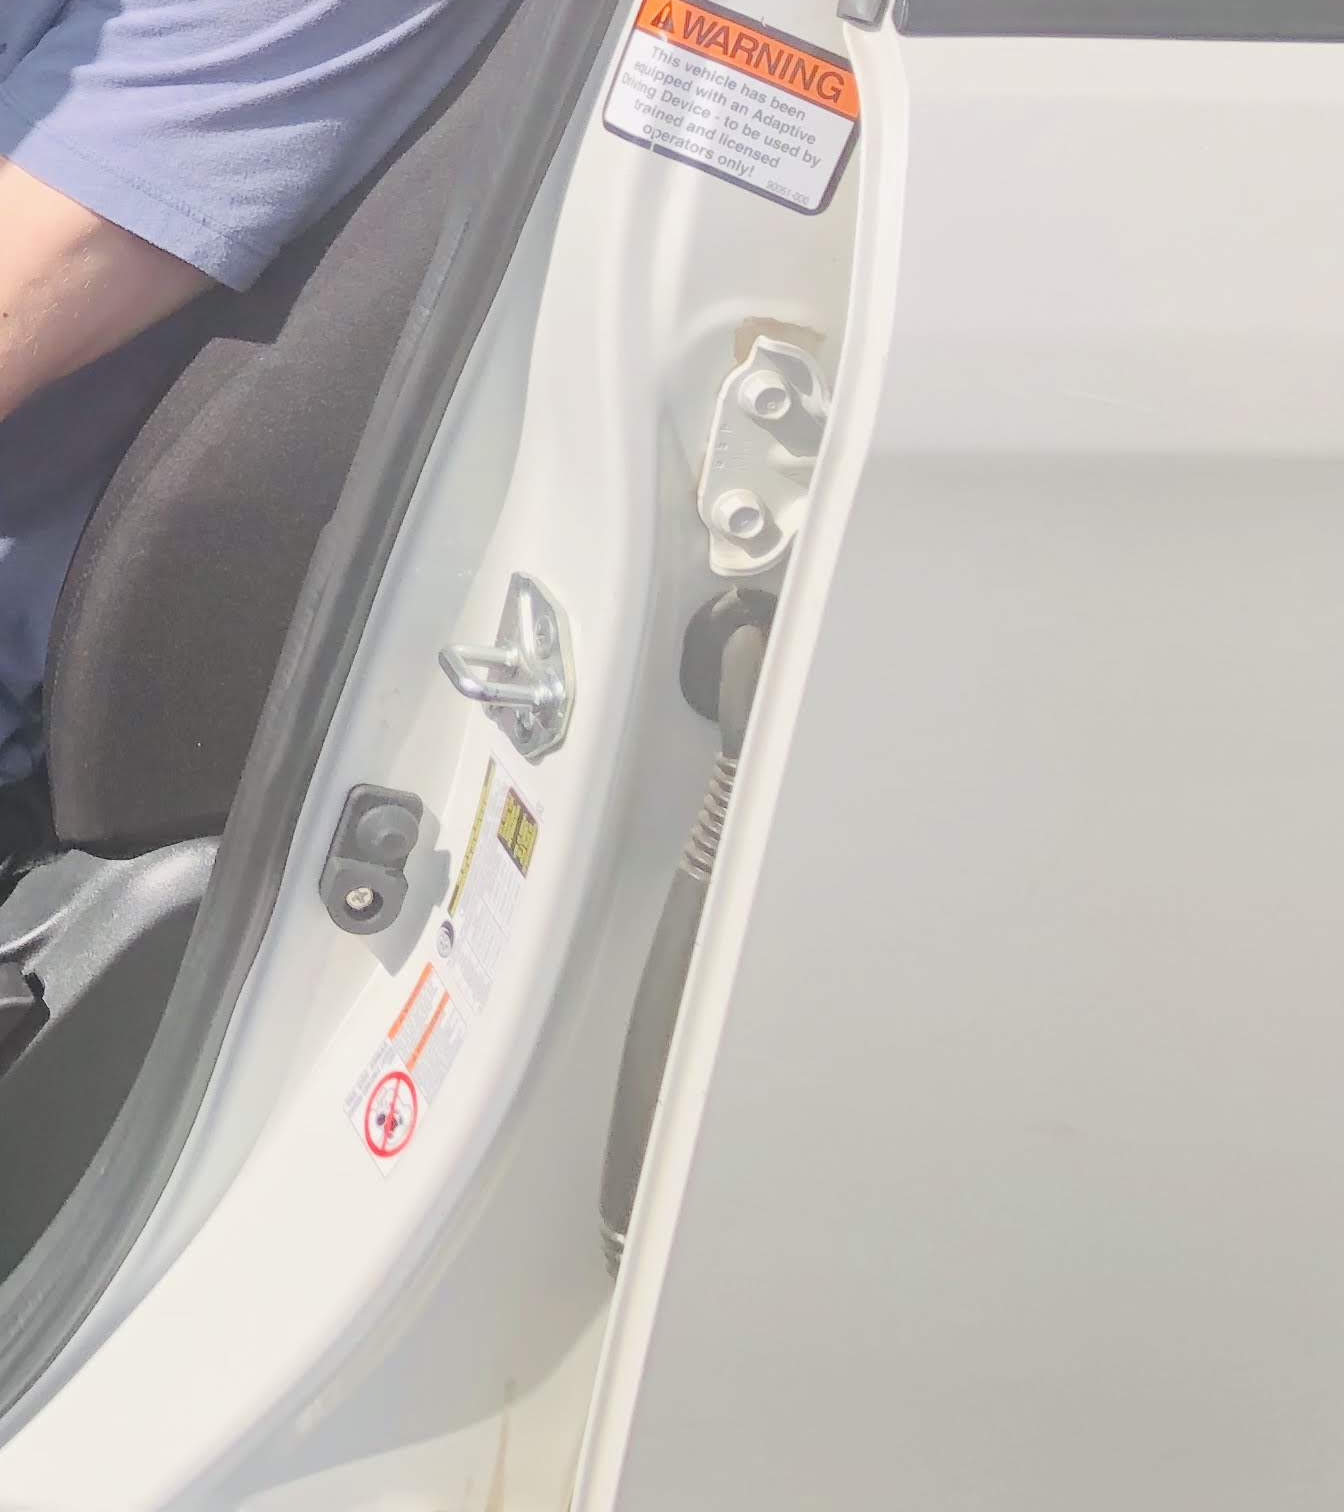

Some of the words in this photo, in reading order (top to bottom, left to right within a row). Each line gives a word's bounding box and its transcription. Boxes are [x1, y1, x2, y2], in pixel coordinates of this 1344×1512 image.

[651, 46, 680, 67] This
[685, 61, 737, 91] vehicle
[740, 83, 767, 104] has
[771, 96, 807, 121] been
[683, 10, 845, 104] WARNING
[621, 72, 658, 99] Driving
[661, 89, 711, 119] Device
[723, 114, 738, 131] to
[741, 121, 761, 140] be
[763, 134, 800, 159] used
[802, 146, 822, 169] by
[633, 61, 692, 94] equipped
[695, 84, 728, 108] with
[730, 101, 749, 116] an
[751, 109, 817, 146] Adaptive
[633, 98, 683, 128] trained
[686, 121, 715, 142] and
[718, 133, 780, 170] licensed
[642, 123, 714, 160] operators
[717, 153, 755, 178] only!
